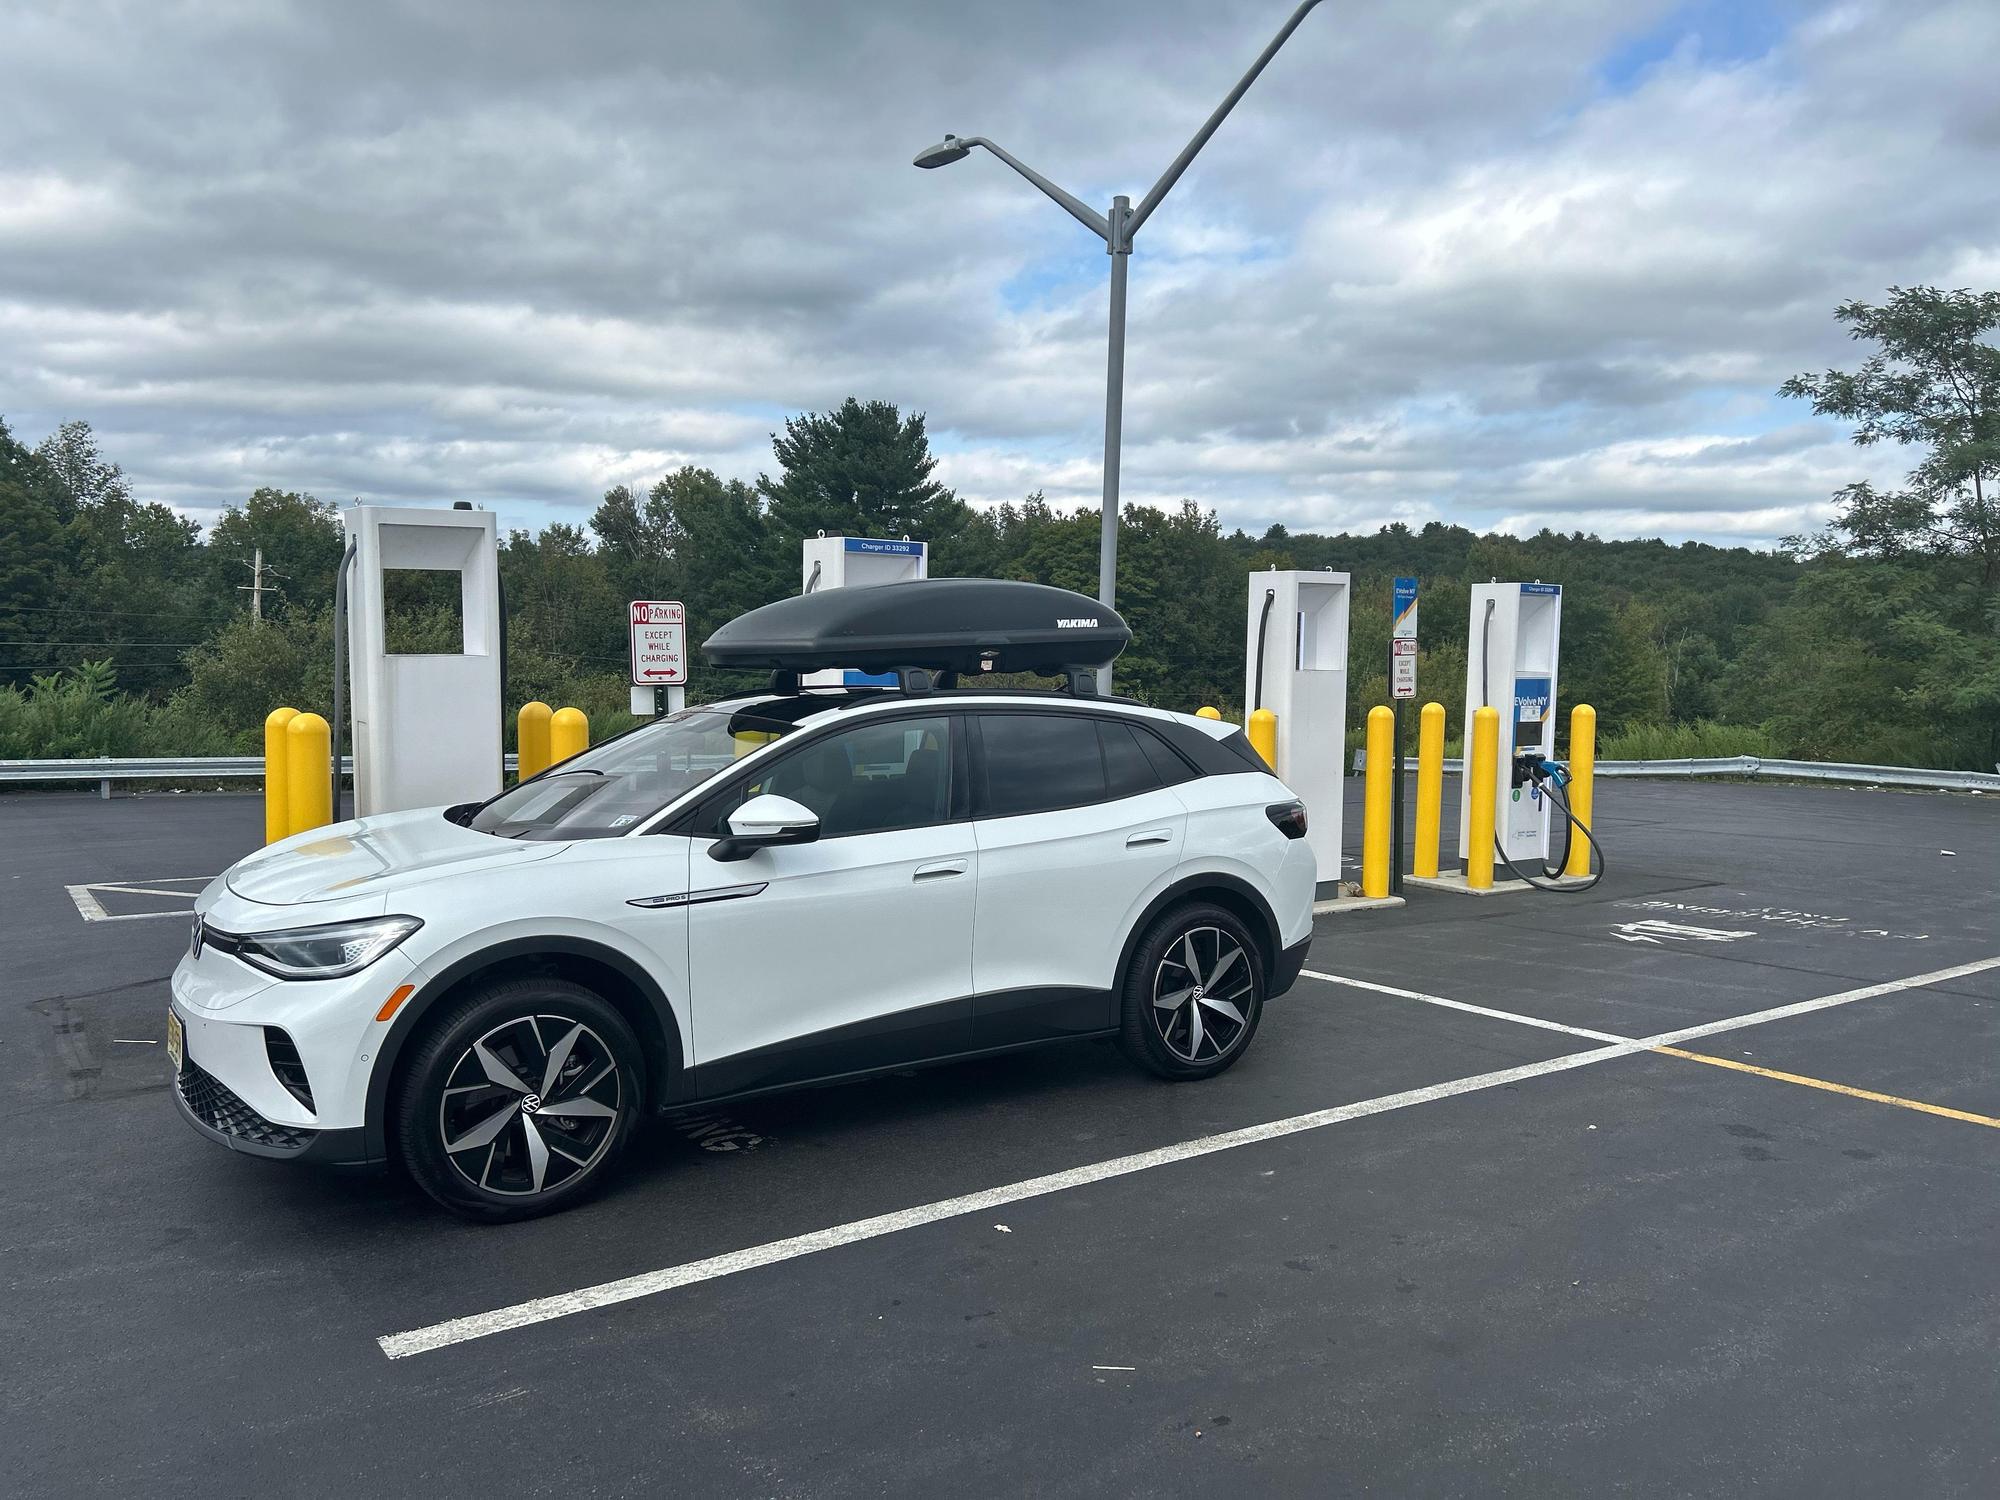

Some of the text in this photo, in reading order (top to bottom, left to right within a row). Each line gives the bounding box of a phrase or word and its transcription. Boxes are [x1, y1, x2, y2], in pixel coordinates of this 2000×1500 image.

[861, 543, 883, 551] Charger
[633, 606, 681, 622] NO PARKING
[1057, 618, 1099, 628] YAKIMA
[645, 631, 672, 639] EXCEPT
[648, 643, 670, 651] WHILE
[641, 654, 679, 662] CHARGING
[1514, 696, 1548, 706] EVolve NY
